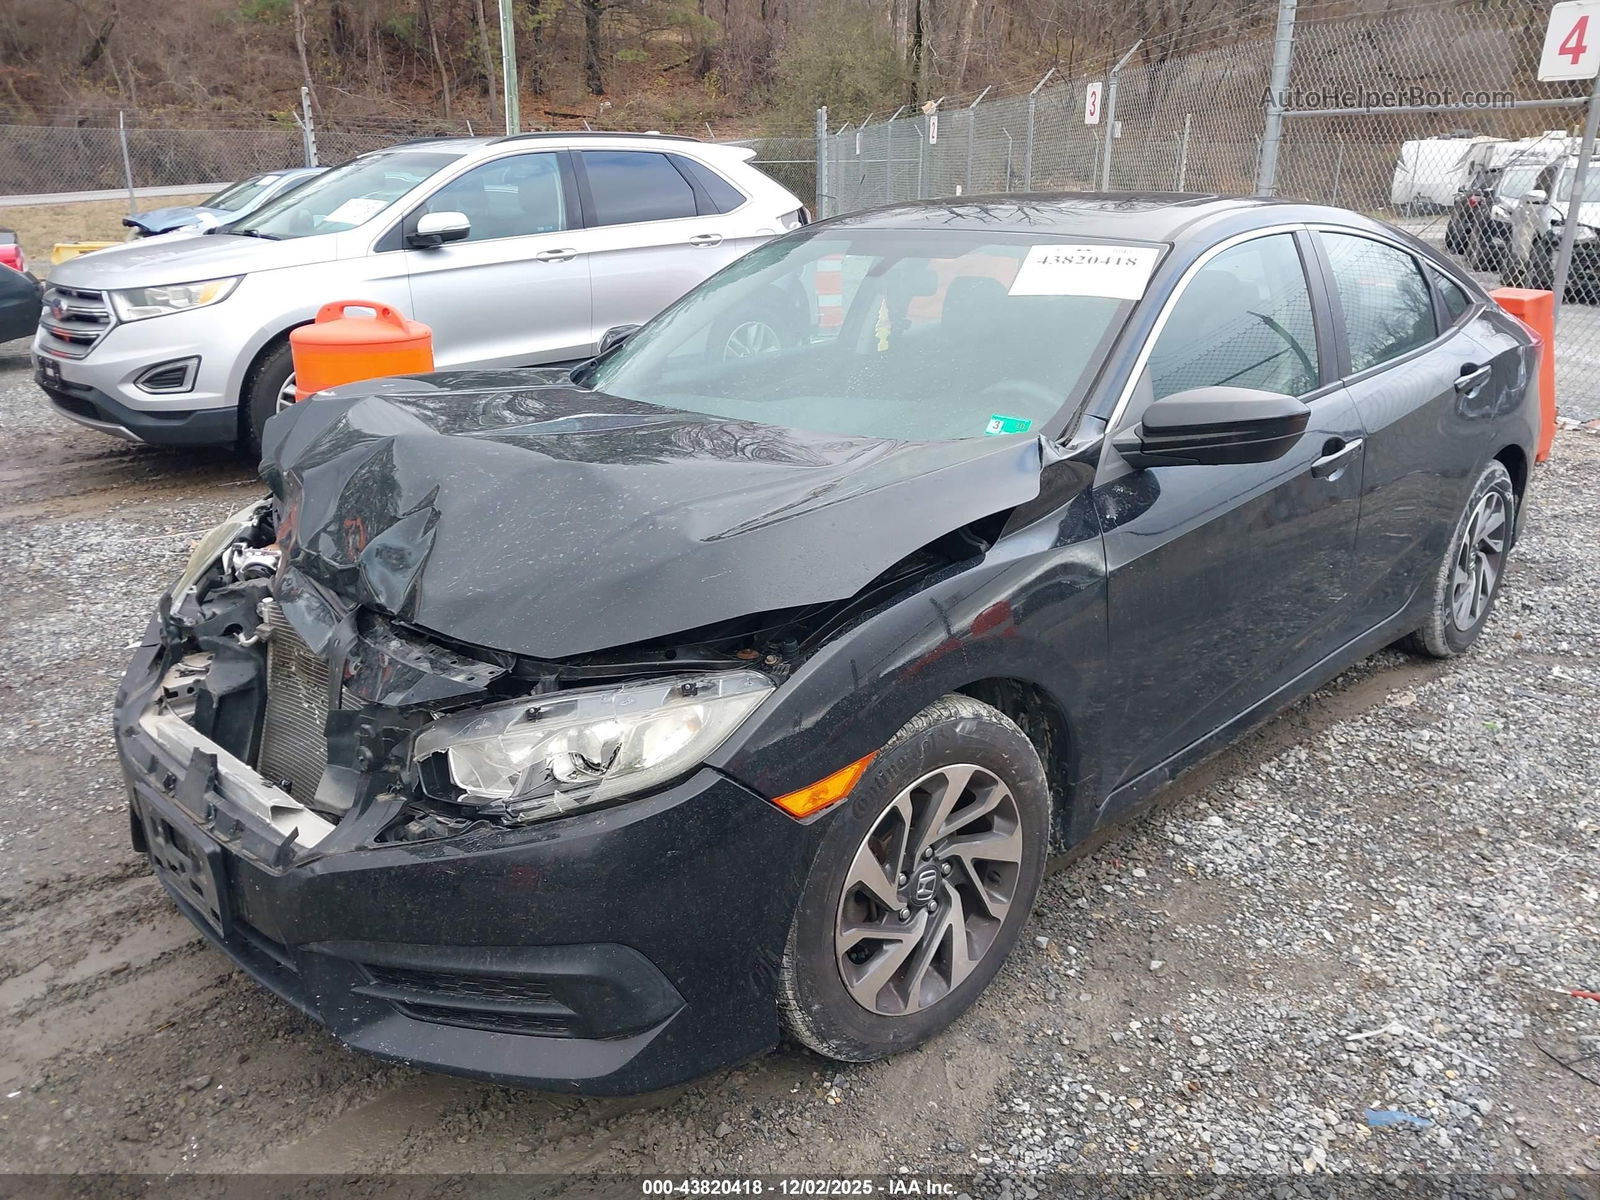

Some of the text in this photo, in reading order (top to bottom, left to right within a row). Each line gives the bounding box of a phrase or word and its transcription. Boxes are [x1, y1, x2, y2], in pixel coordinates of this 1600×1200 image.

[1558, 14, 1590, 65] 4
[1089, 90, 1097, 117] 3
[1037, 255, 1138, 266] 43820418
[992, 420, 1001, 430] 3
